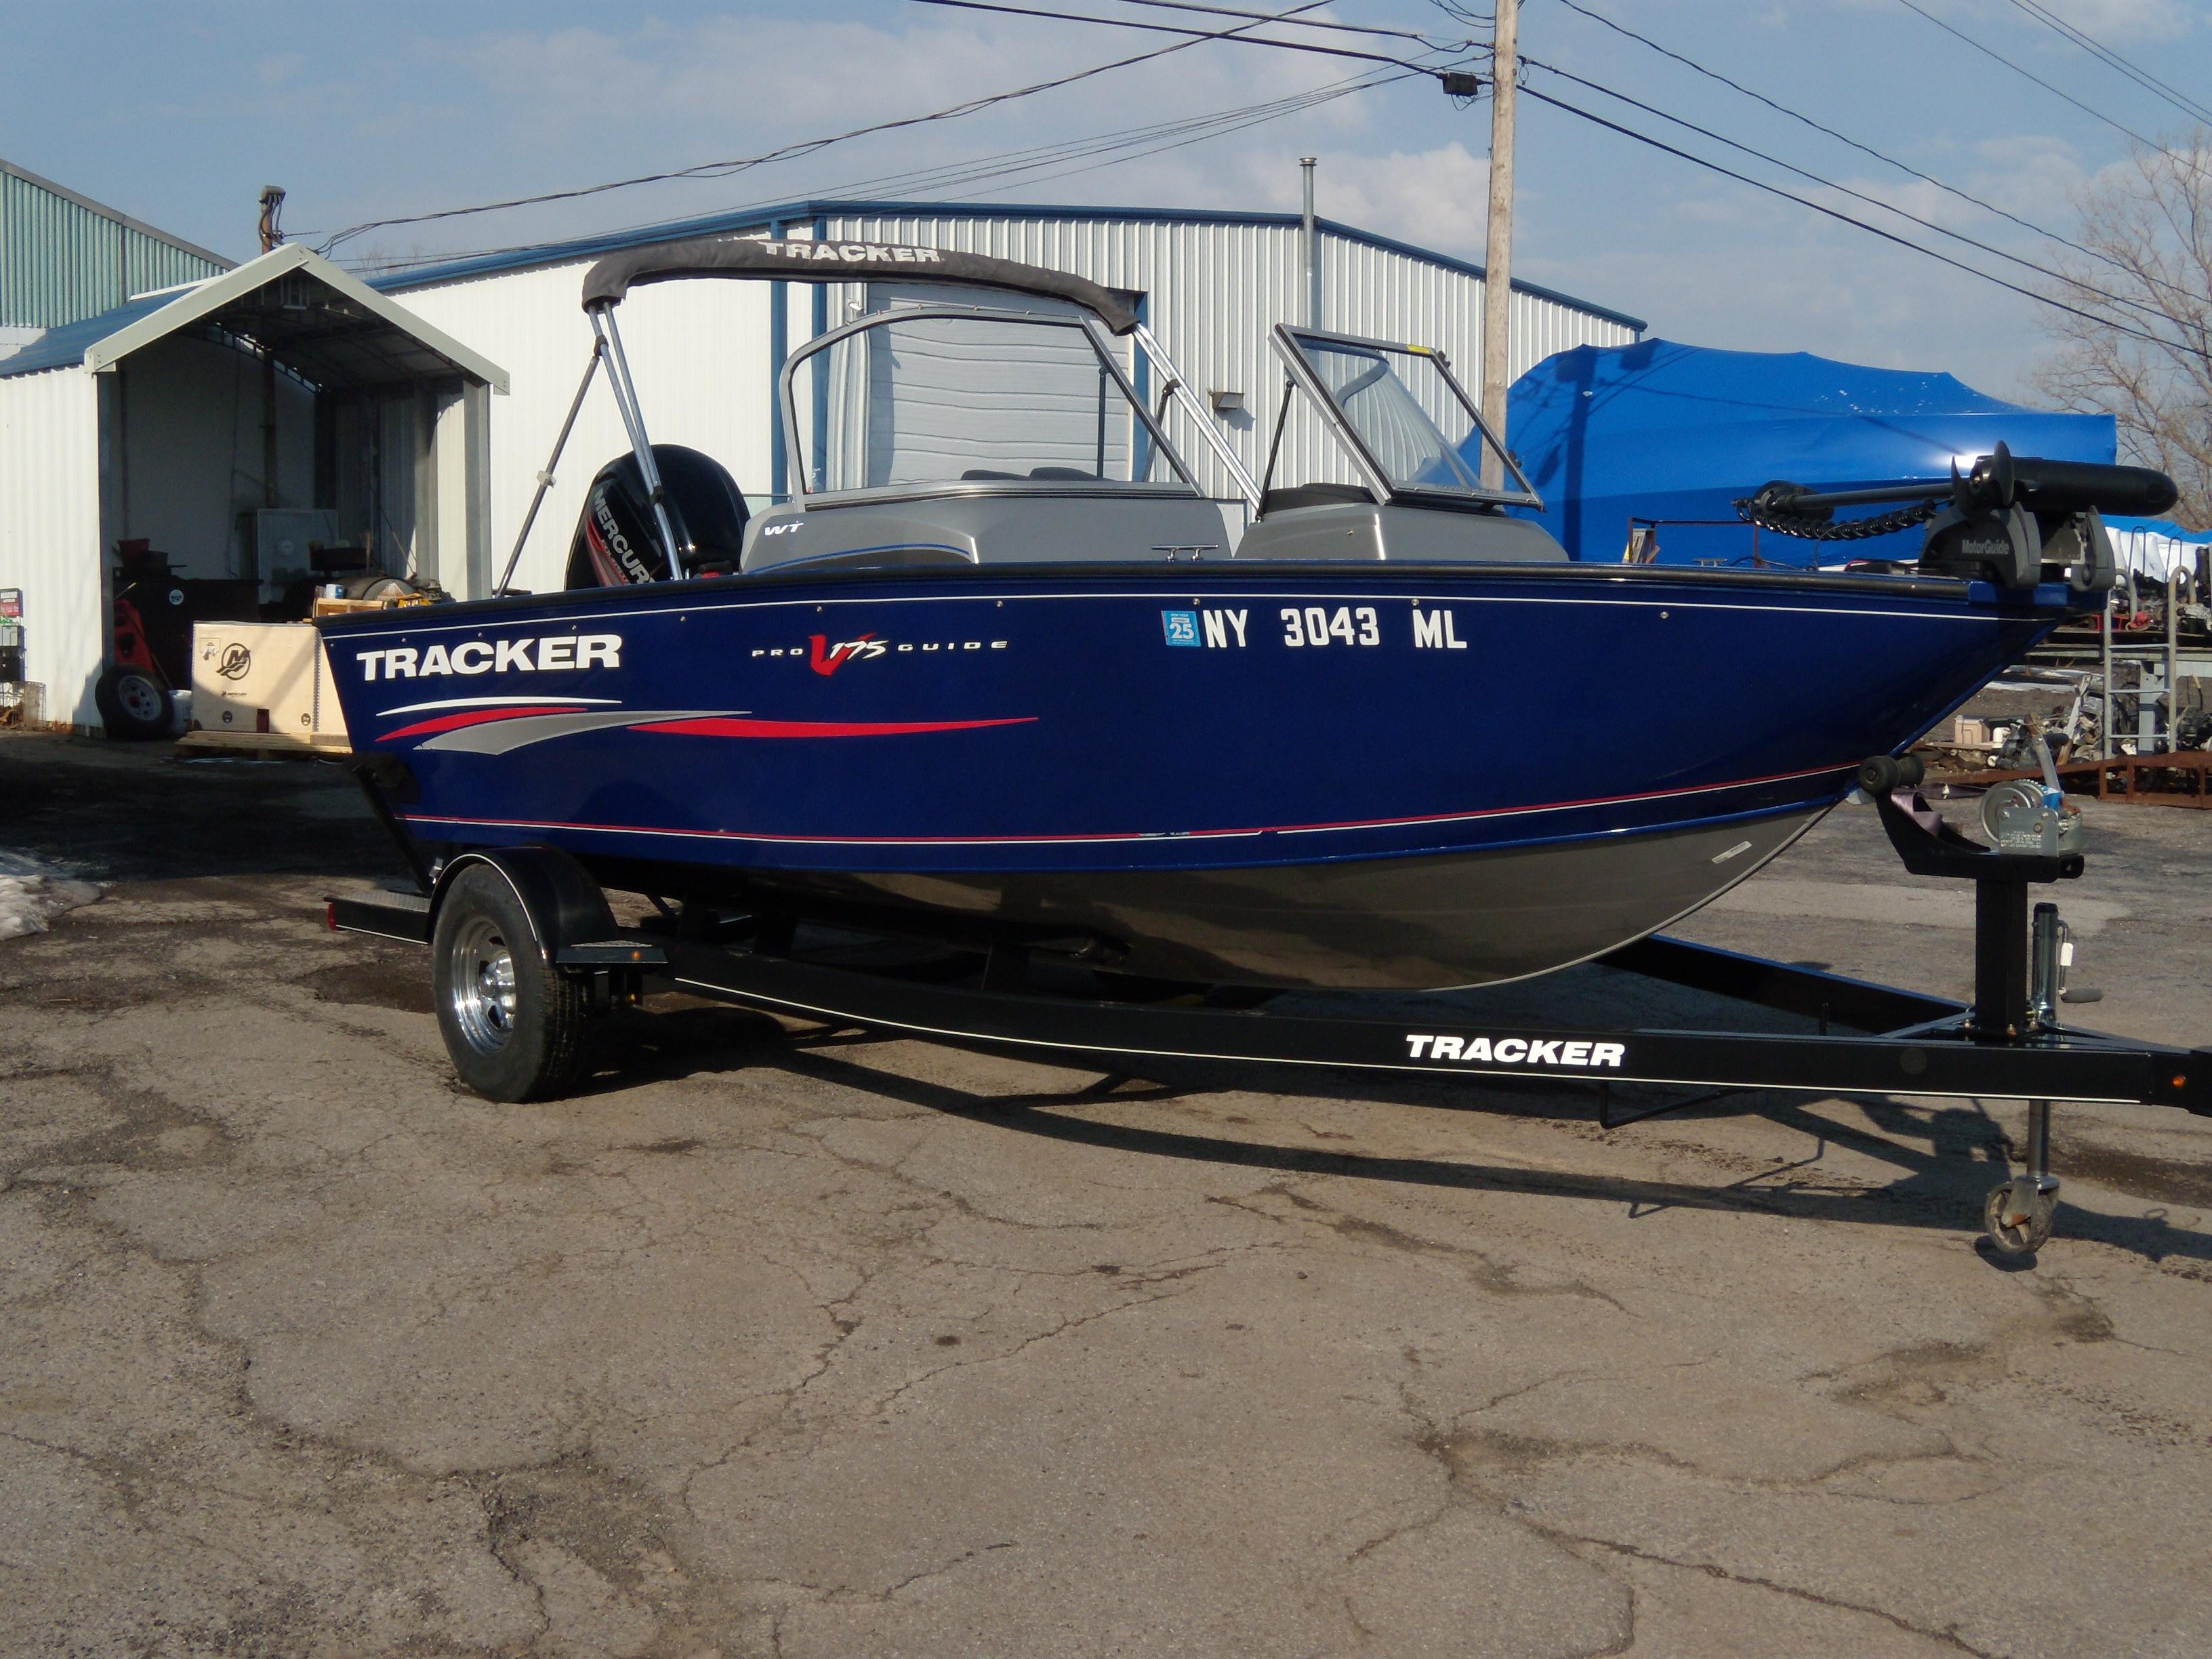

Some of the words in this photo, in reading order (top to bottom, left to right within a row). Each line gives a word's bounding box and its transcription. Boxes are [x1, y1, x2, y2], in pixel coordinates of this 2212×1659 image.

[758, 241, 941, 262] TRACKER
[594, 487, 655, 584] MERCUR
[1962, 539, 2010, 555] MotorGuide
[1169, 622, 1195, 640] 25
[1202, 609, 1248, 649] NY
[1280, 607, 1380, 647] 3043
[1412, 609, 1468, 649] ML
[356, 634, 623, 682] TRACKER
[751, 647, 804, 657] PRO
[897, 640, 1009, 652] GUIDE
[1406, 1034, 1626, 1067] TRACKER
